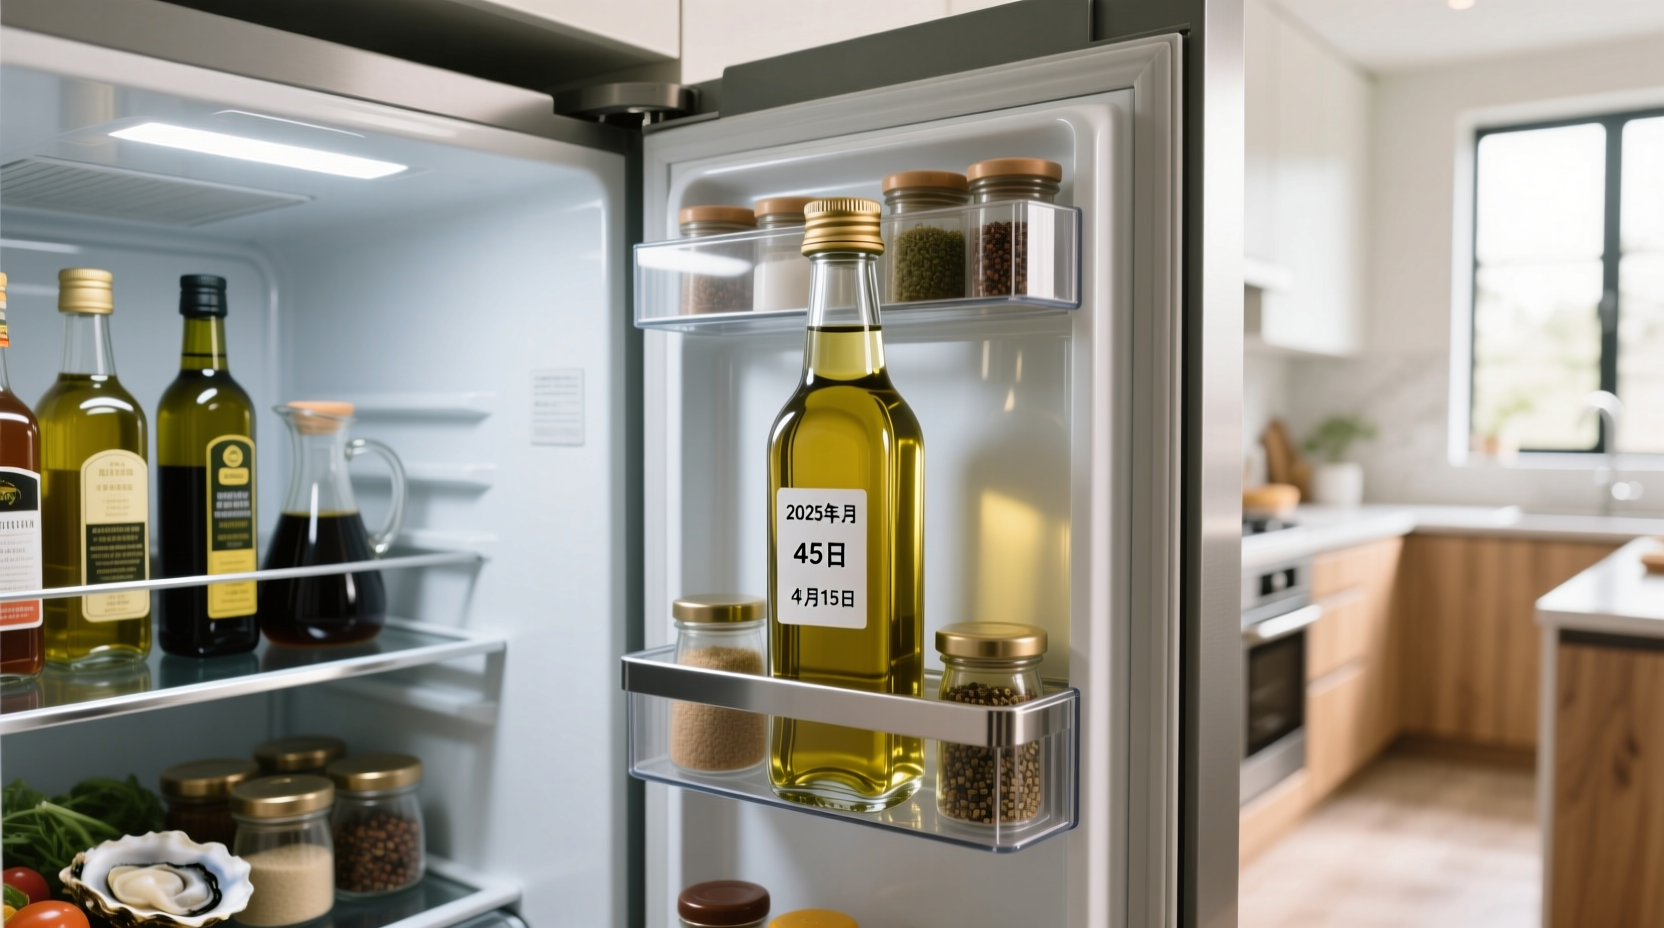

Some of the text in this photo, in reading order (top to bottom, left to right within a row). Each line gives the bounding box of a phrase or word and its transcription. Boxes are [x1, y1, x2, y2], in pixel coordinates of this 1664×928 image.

[786, 502, 856, 524] 2025年月
[793, 542, 845, 568] 45日
[791, 587, 854, 608] 4月15日
